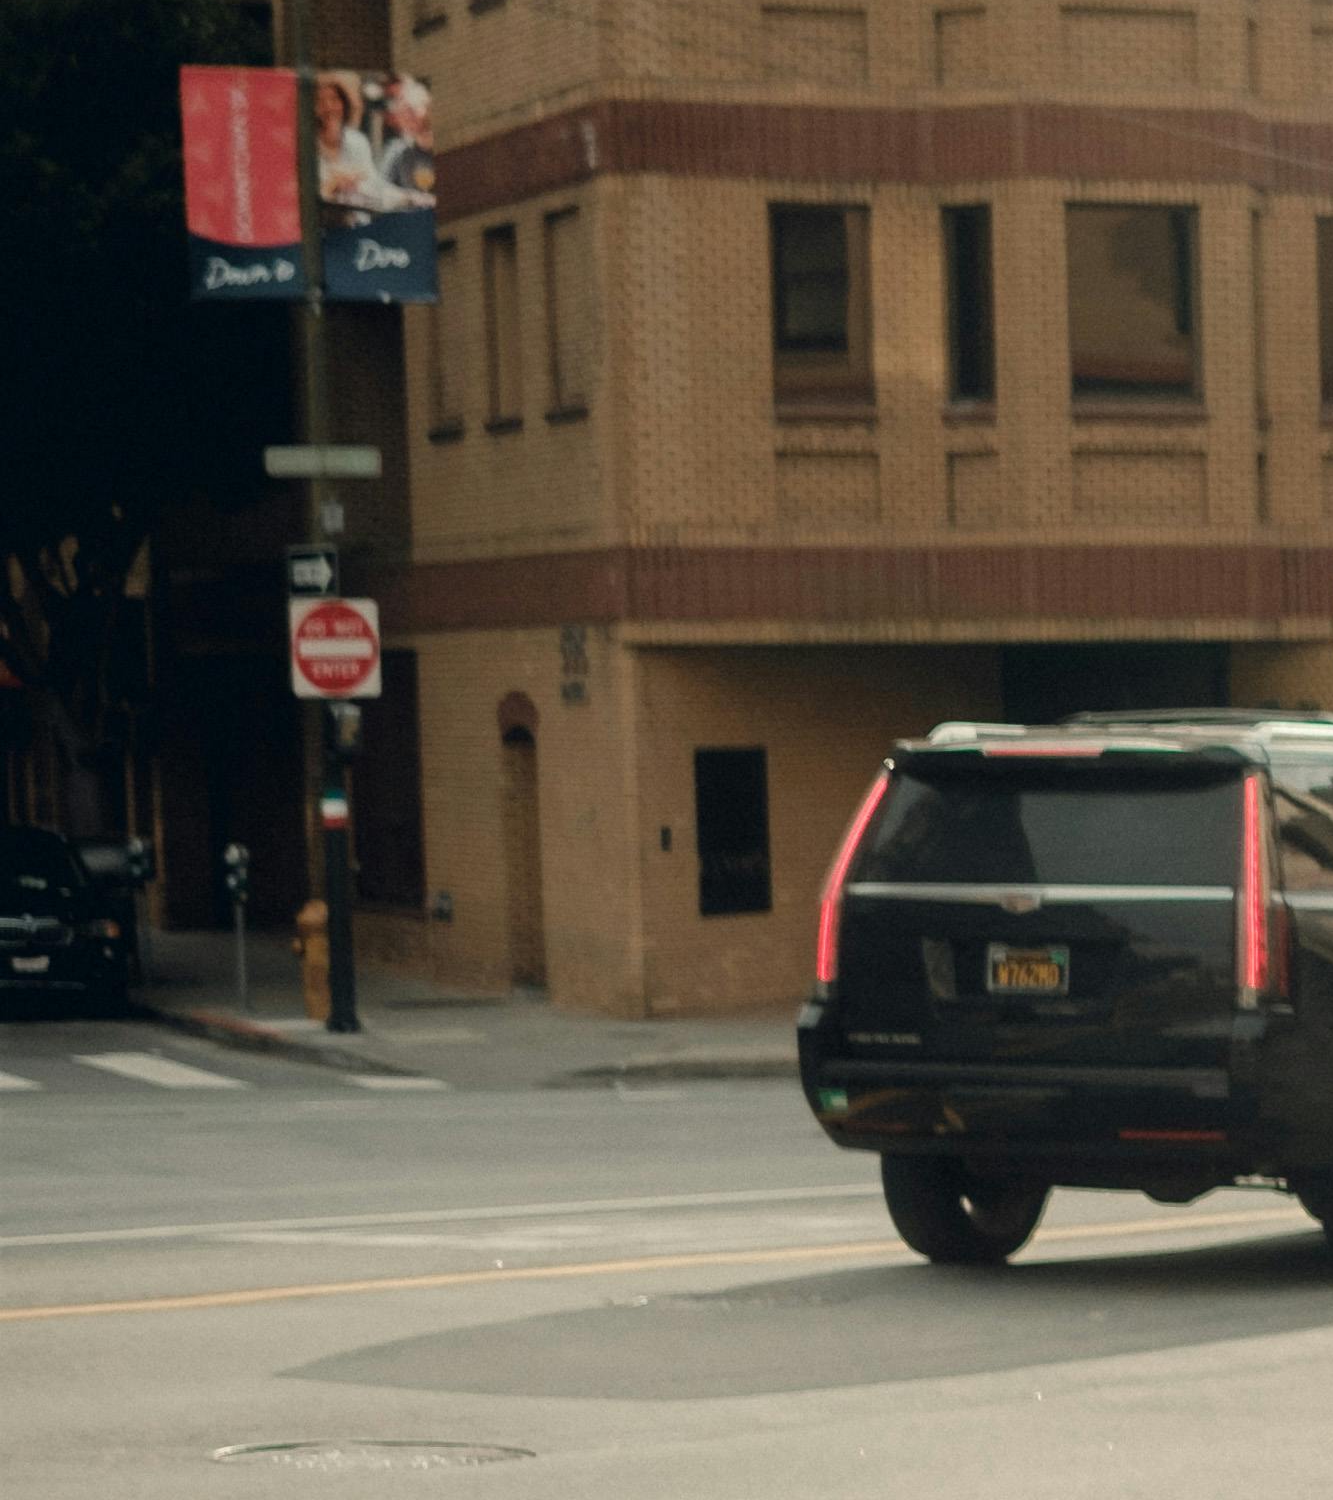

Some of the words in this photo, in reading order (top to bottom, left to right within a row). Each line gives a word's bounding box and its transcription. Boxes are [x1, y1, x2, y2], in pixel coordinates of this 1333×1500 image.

[304, 619, 327, 636] DO
[334, 619, 364, 636] NOT
[311, 662, 361, 680] ENTER
